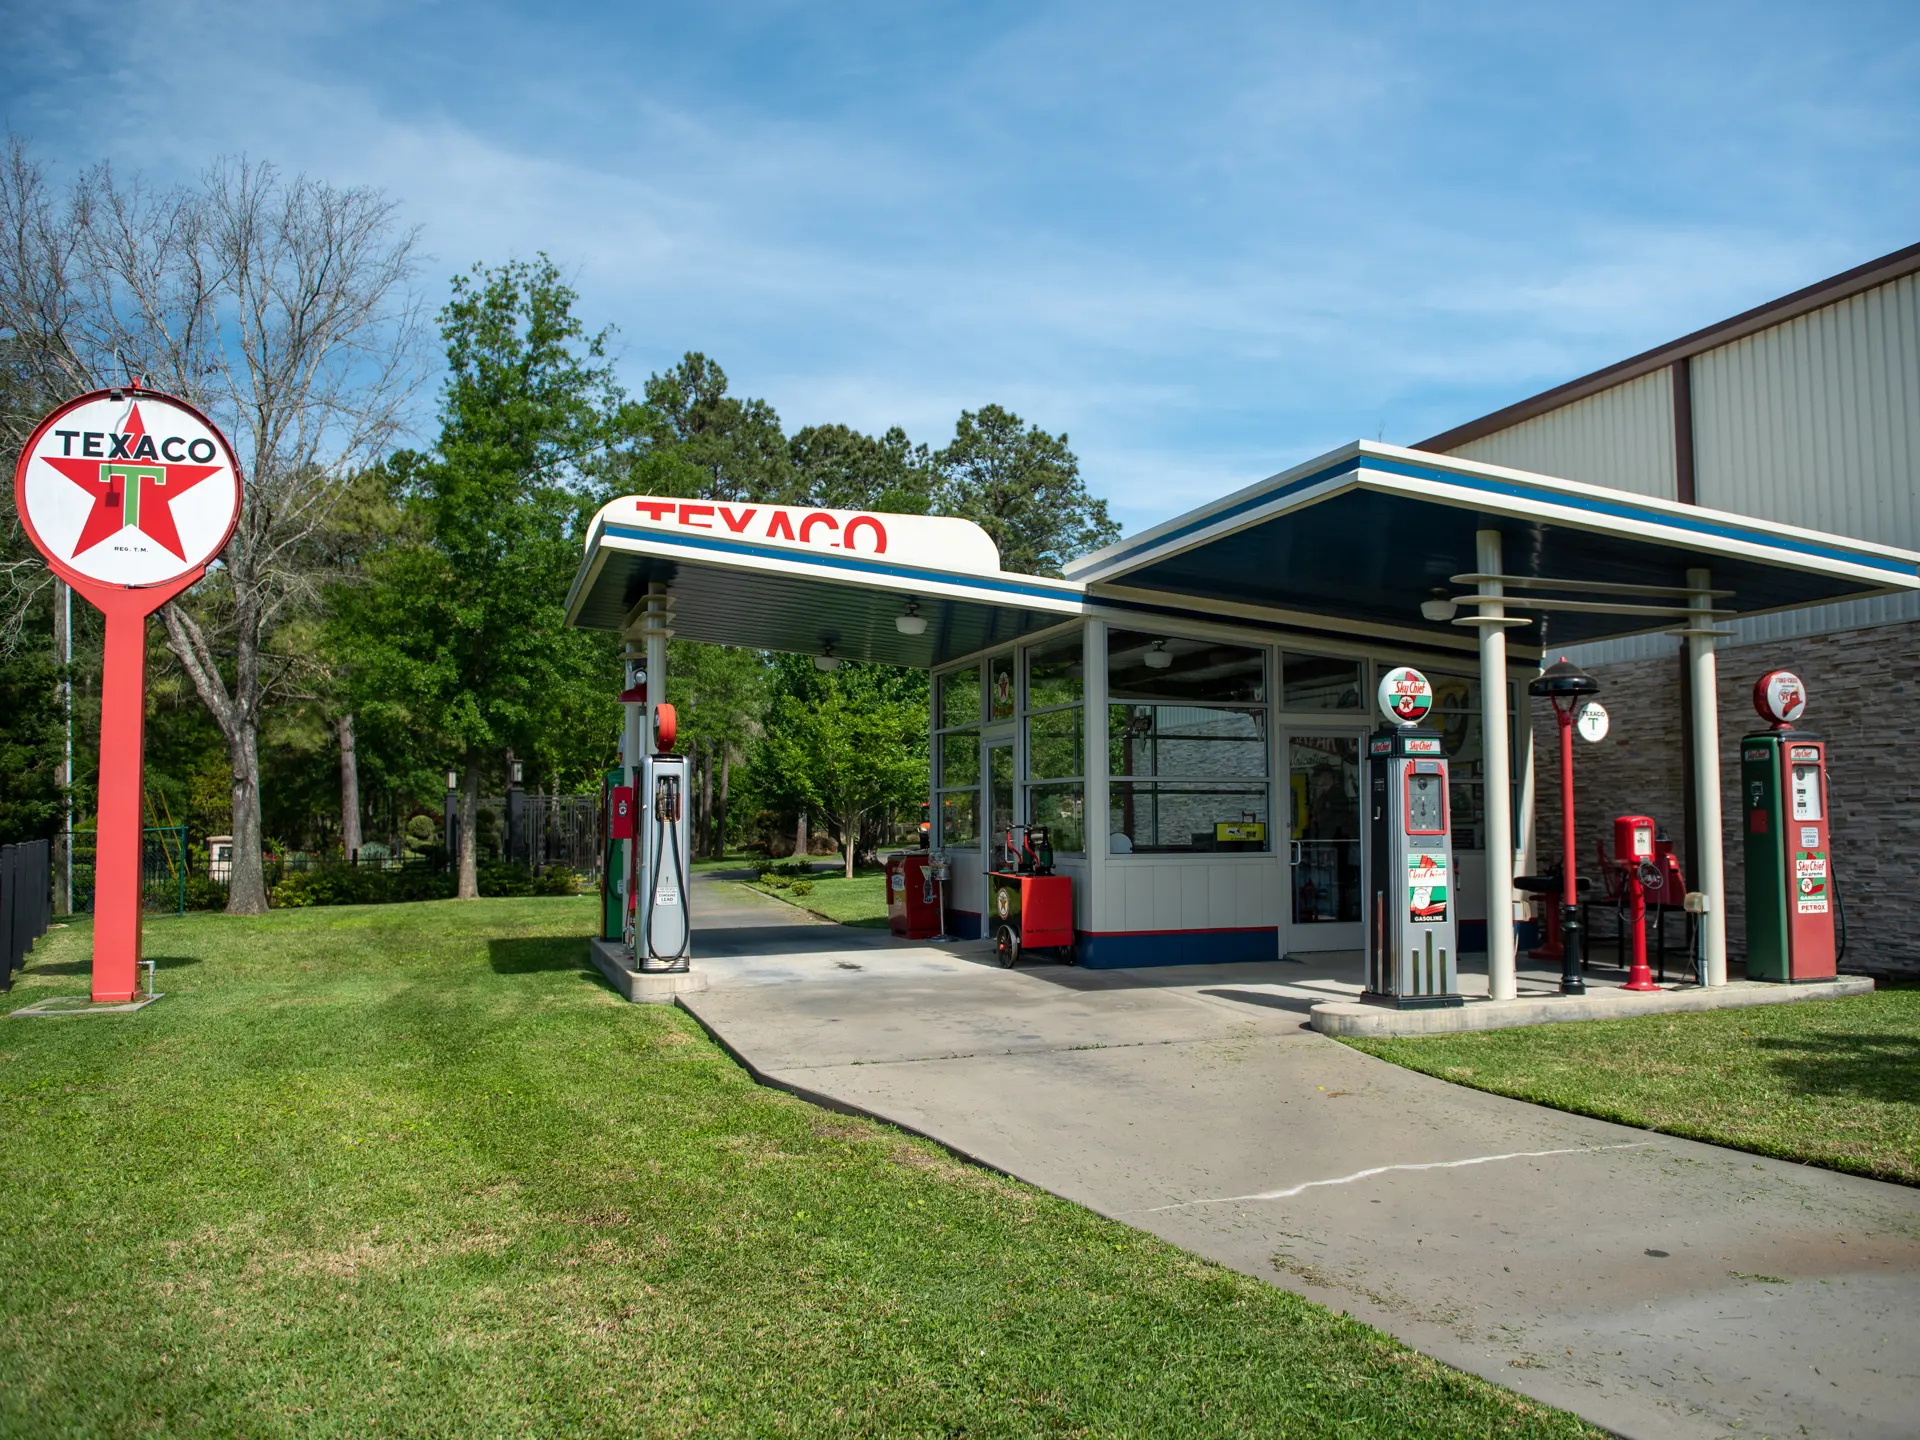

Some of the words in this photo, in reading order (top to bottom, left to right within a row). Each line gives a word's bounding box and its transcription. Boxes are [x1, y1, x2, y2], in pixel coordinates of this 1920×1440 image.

[55, 430, 216, 464] TEXACO
[1797, 860, 1809, 872] Sky
[1810, 860, 1826, 872] Chief
